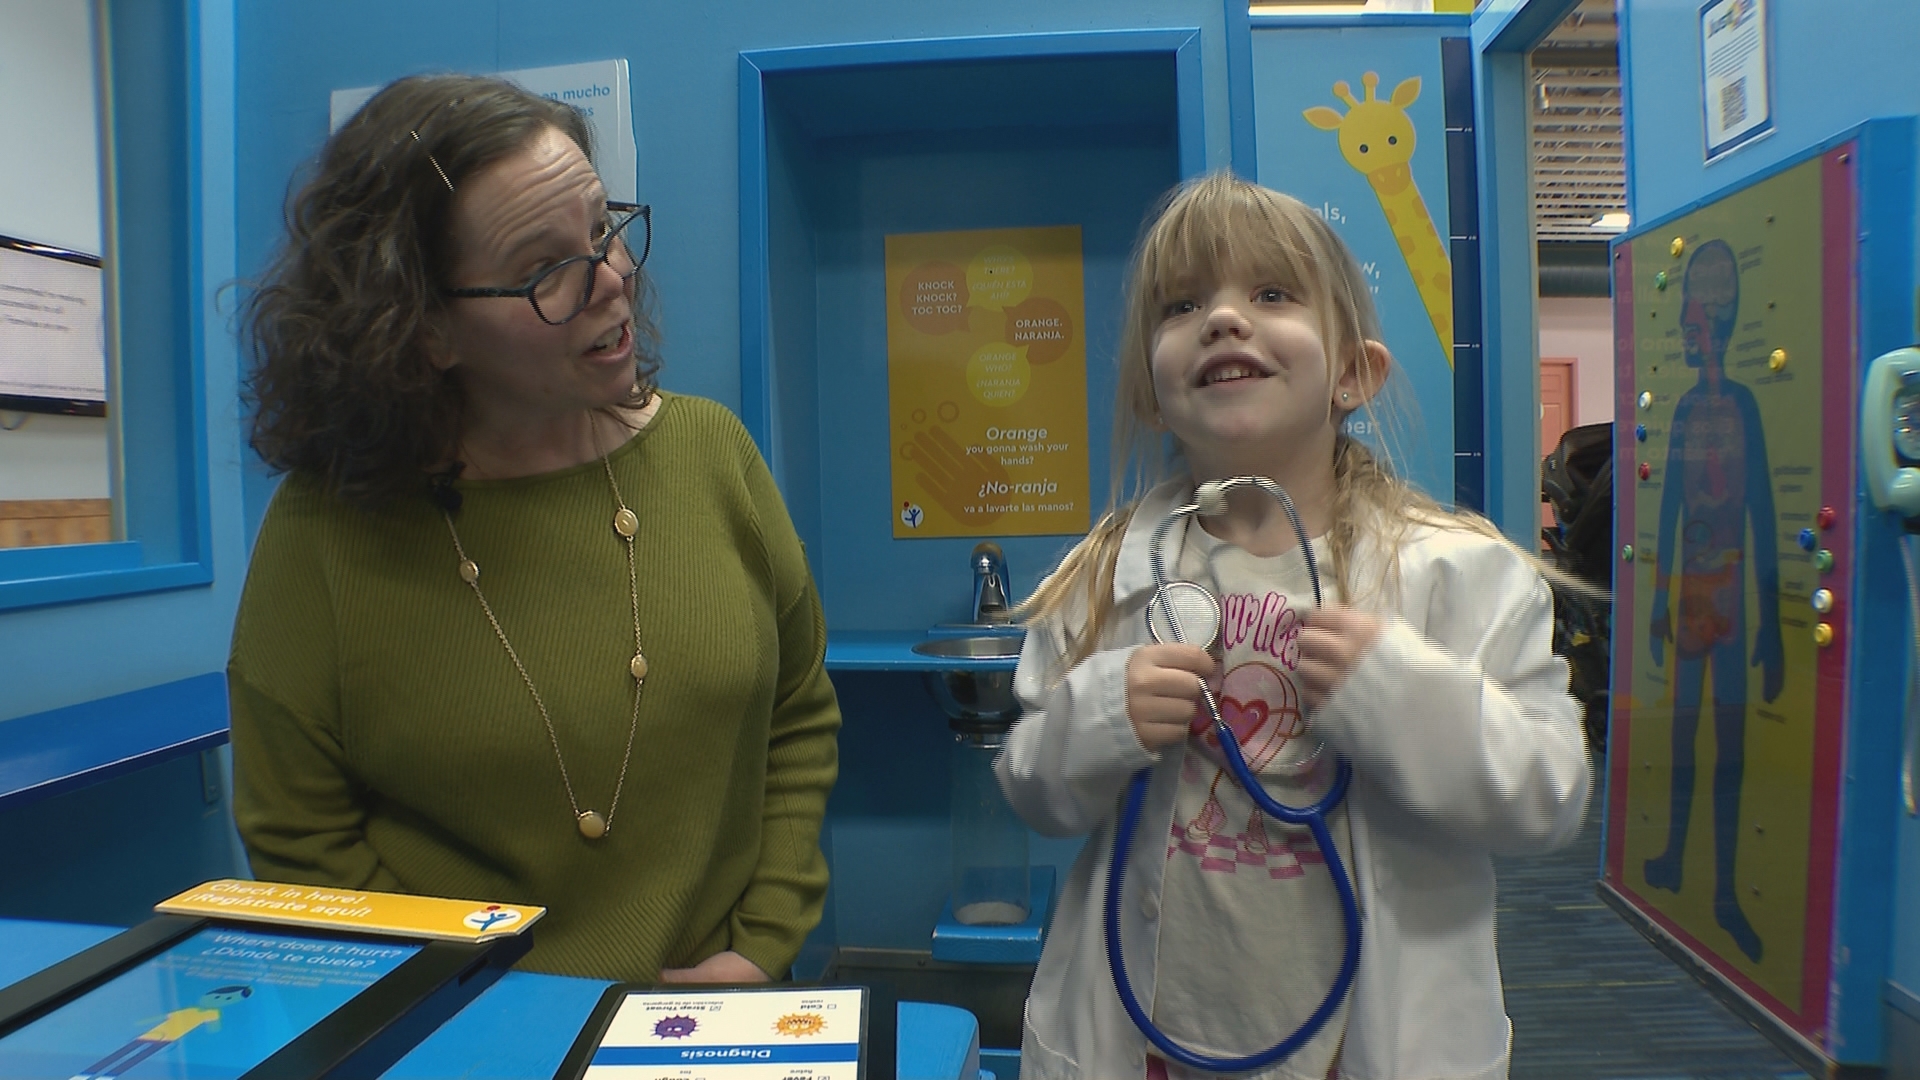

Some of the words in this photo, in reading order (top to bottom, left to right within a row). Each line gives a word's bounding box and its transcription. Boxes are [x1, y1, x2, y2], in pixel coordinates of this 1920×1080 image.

[563, 84, 611, 100] mucho
[918, 281, 955, 291] KNOCK
[916, 293, 957, 303] KNOCK?
[912, 306, 933, 315] TOC
[936, 305, 962, 315] TOC?
[1015, 318, 1063, 328] ORANGE.
[1014, 330, 1065, 341] NARANJA.
[979, 352, 1017, 361] ORANGE
[985, 364, 1012, 373] WHO?
[986, 426, 1048, 442] Orange
[965, 445, 984, 455] you
[986, 445, 1017, 455] gonna
[1019, 442, 1044, 452] wash
[1046, 442, 1069, 454] your
[1000, 456, 1034, 466] hands?
[978, 478, 1058, 498] ¿No-ranja
[964, 505, 975, 513] va
[978, 505, 984, 513] a
[986, 503, 1019, 513] lavarte
[1022, 503, 1035, 512] las
[1038, 502, 1074, 512] manos?
[209, 883, 278, 897] Check
[279, 888, 302, 898] in
[304, 890, 367, 905] here!
[213, 934, 276, 947] Where
[278, 940, 324, 953] does
[327, 944, 344, 954] it
[346, 945, 403, 959] hurt?
[201, 946, 280, 961] ¿Dónde
[282, 953, 304, 962] te
[306, 954, 377, 969] duele?
[681, 1048, 771, 1060] Diagnosis
